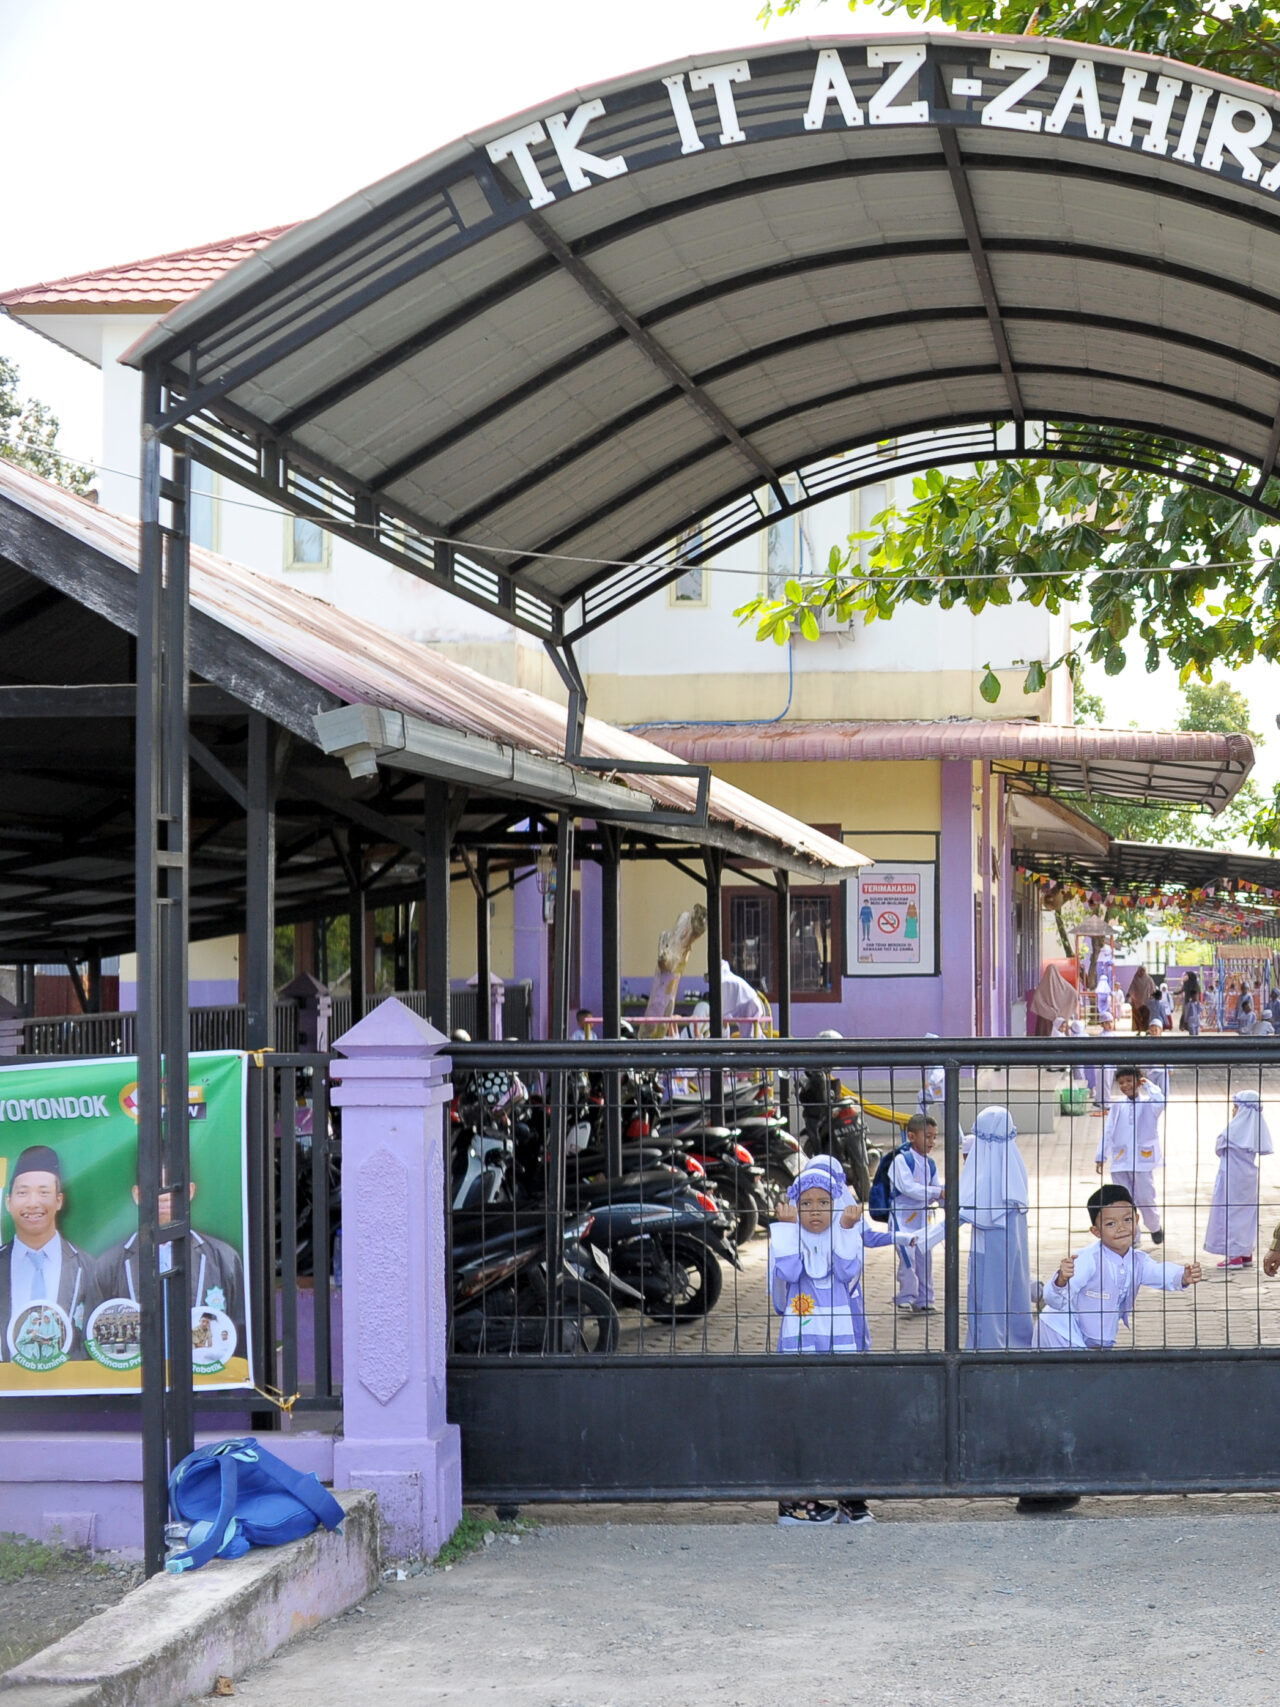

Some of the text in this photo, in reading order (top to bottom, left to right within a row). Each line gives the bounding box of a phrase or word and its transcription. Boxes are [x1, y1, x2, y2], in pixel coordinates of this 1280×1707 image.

[485, 99, 628, 210] TK
[661, 59, 751, 155] IT
[864, 885, 915, 893] TERIMAKASIH
[15, 1354, 67, 1370] Kitab Kuning
[88, 1341, 129, 1369] Pembinaan
